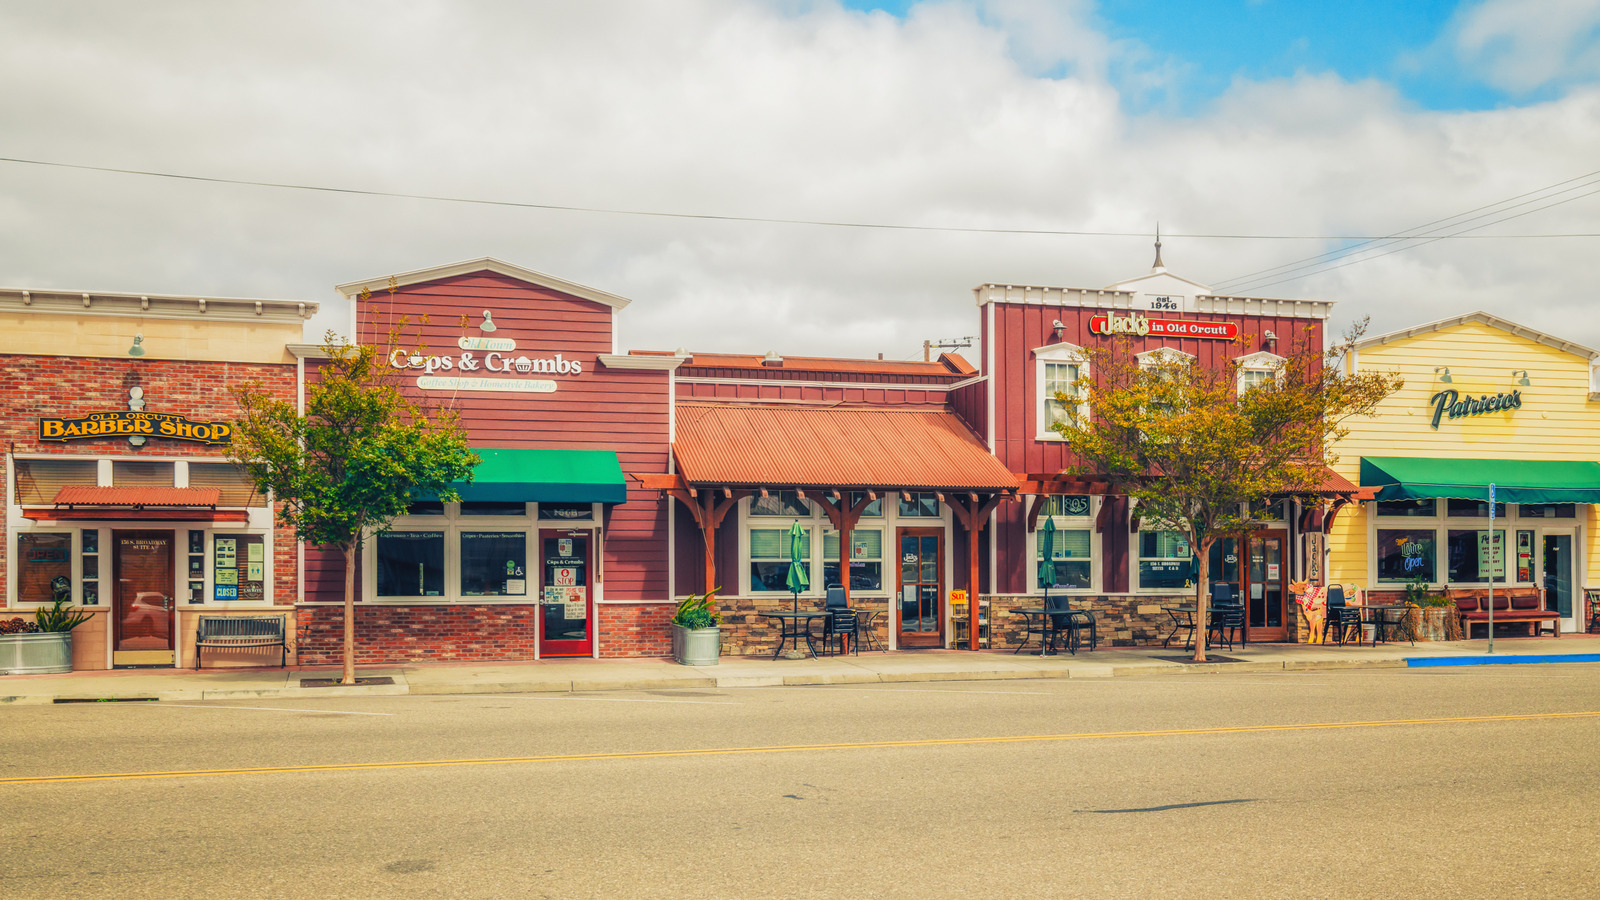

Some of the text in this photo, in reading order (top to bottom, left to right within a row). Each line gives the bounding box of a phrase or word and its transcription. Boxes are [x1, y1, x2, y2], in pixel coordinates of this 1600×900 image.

[1151, 302, 1178, 310] 1946
[1100, 311, 1228, 335] Jack's in Old Orcutt
[462, 338, 513, 350] Old Town
[458, 352, 480, 371] &
[420, 378, 447, 389] Coffee
[448, 379, 469, 389] Shop
[480, 379, 523, 390] Homestyle
[524, 380, 554, 391] Bakery
[1430, 389, 1522, 431] Patricio's
[90, 412, 185, 423] OLD ORCUTT
[42, 419, 231, 440] BARBER SHOP
[1064, 498, 1088, 509] 805
[556, 577, 575, 586] STOP
[216, 587, 238, 597] CLOSED
